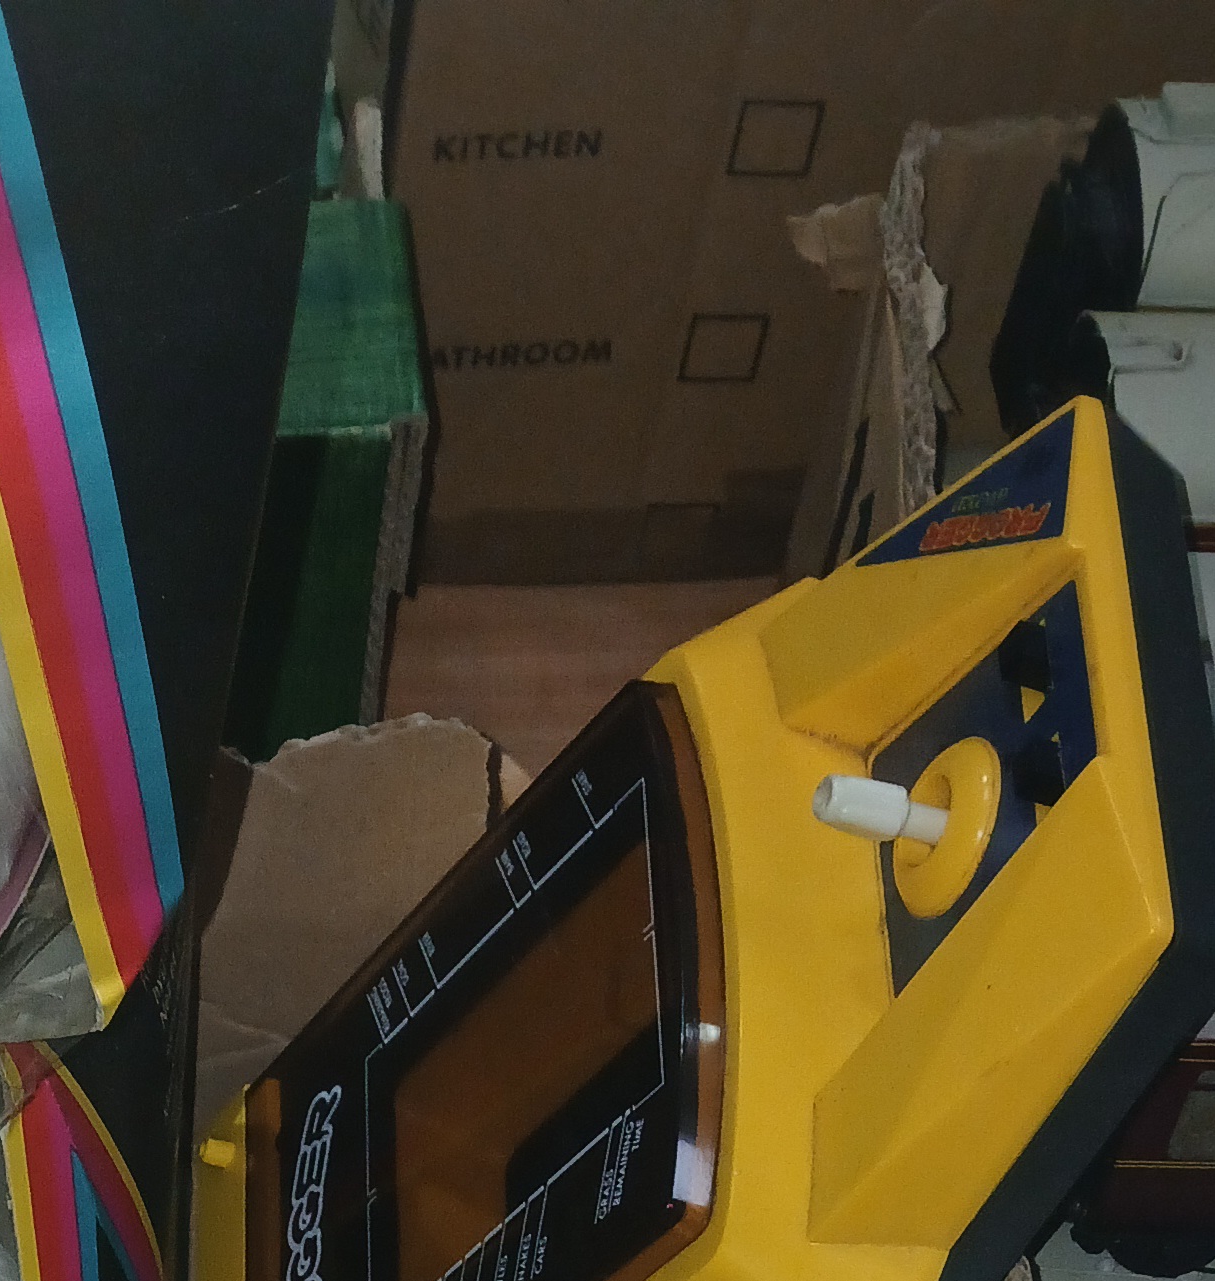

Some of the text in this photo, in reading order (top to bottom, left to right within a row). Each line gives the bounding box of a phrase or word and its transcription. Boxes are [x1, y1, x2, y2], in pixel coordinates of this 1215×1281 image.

[433, 130, 603, 162] KITCHEN
[434, 339, 613, 369] ATHROOM
[632, 1118, 645, 1152] TIME
[613, 1120, 635, 1206] REMAINING
[598, 1168, 614, 1220] GRASS
[533, 1235, 548, 1275] CARS
